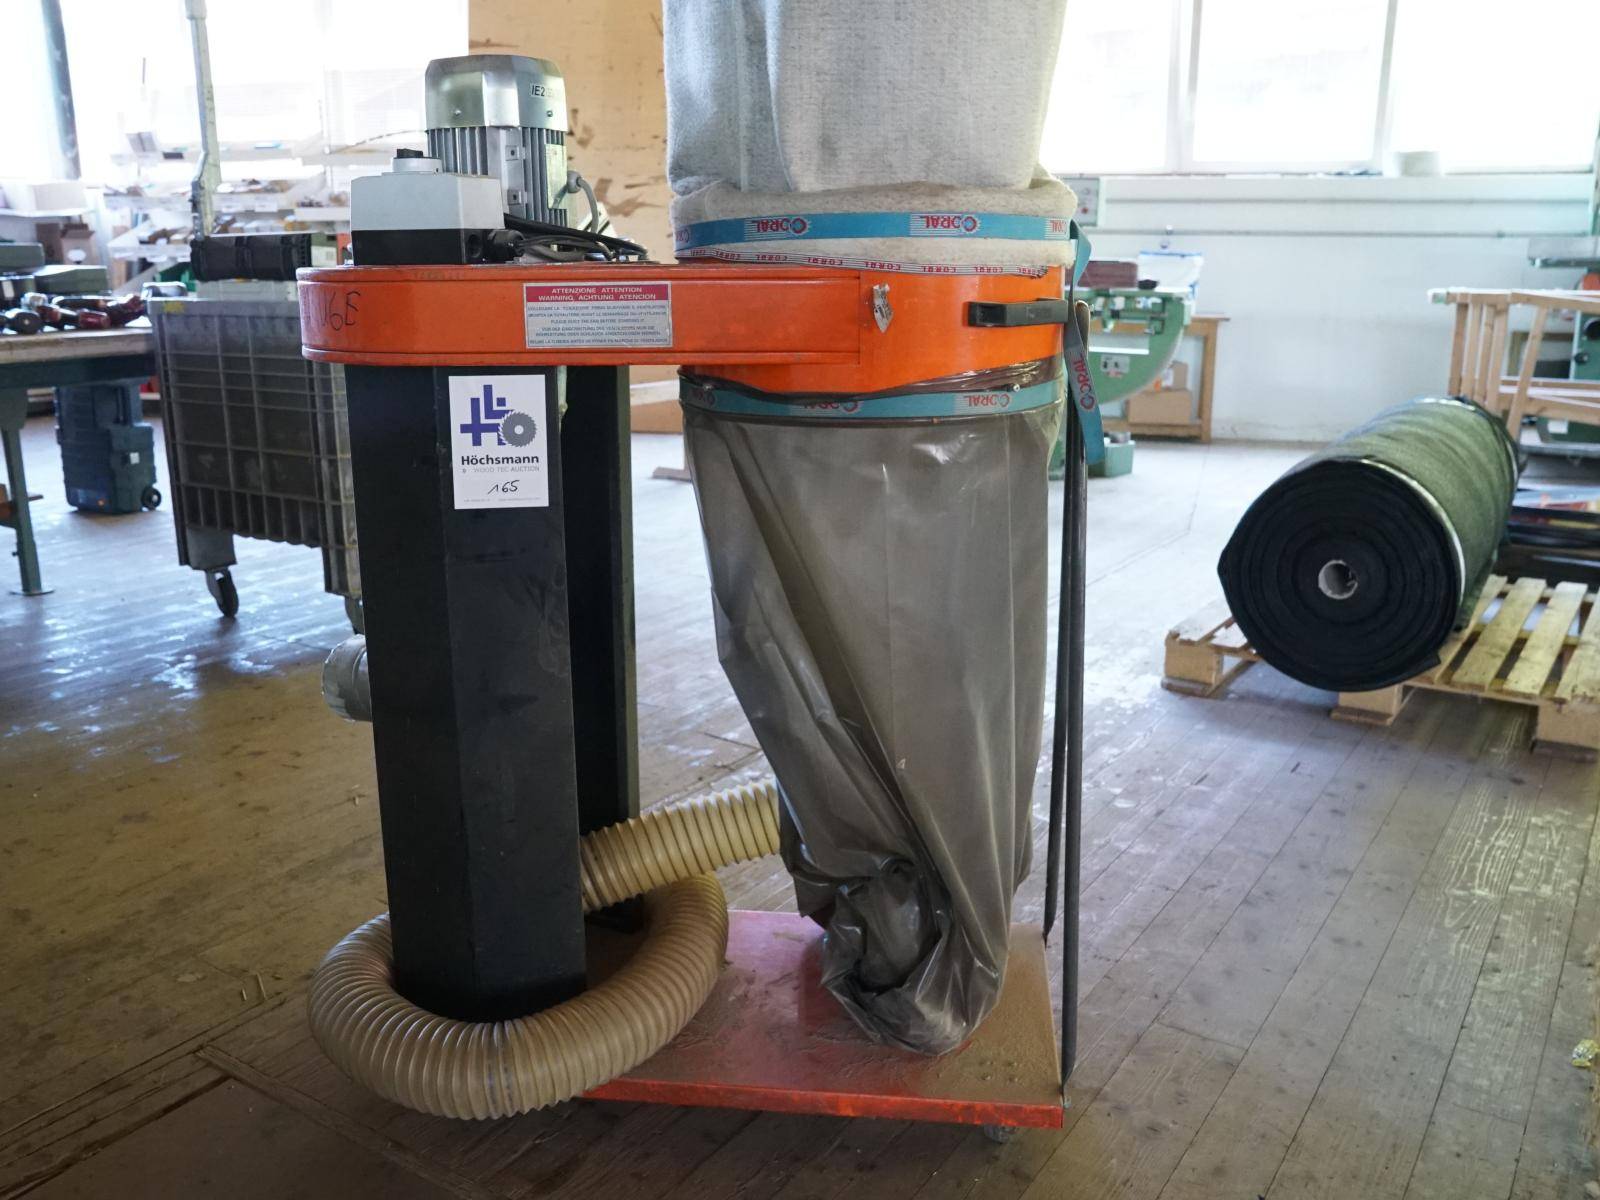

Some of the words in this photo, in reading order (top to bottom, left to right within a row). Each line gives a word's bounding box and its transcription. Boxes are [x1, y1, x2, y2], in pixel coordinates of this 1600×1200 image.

[531, 84, 546, 97] IE2
[752, 217, 808, 235] CORAL
[919, 215, 978, 232] CORAL
[755, 254, 788, 262] CORAL
[807, 257, 843, 266] CORAL
[864, 261, 901, 271] CORAL
[921, 265, 957, 273] CORAL
[552, 287, 596, 295] ATTENZIONE
[601, 286, 643, 294] ATTENTION
[619, 293, 656, 301] ATENCION
[1072, 354, 1096, 410] CORAL
[964, 393, 1010, 408] CORAL
[461, 454, 540, 466] Höchsmann
[510, 465, 540, 473] AUCTION
[487, 479, 521, 495] 165
